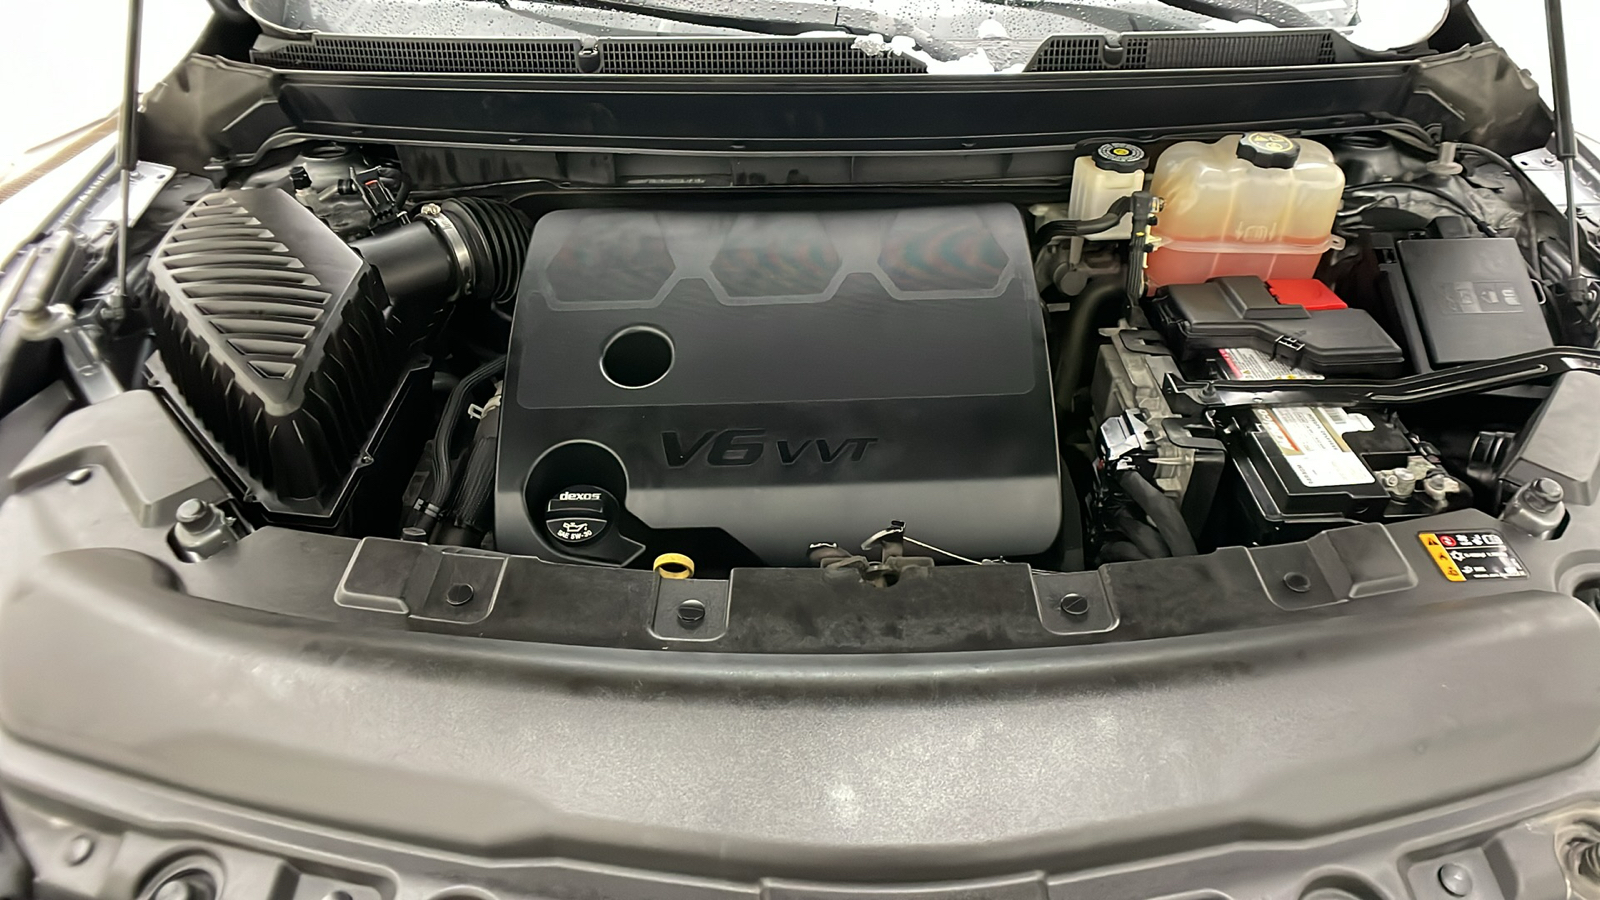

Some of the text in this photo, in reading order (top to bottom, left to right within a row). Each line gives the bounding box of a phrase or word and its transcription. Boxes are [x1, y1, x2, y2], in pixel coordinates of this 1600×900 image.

[661, 428, 878, 469] V6 VVT
[559, 491, 602, 501] dexos
[557, 529, 593, 540] SAE 5W-30
